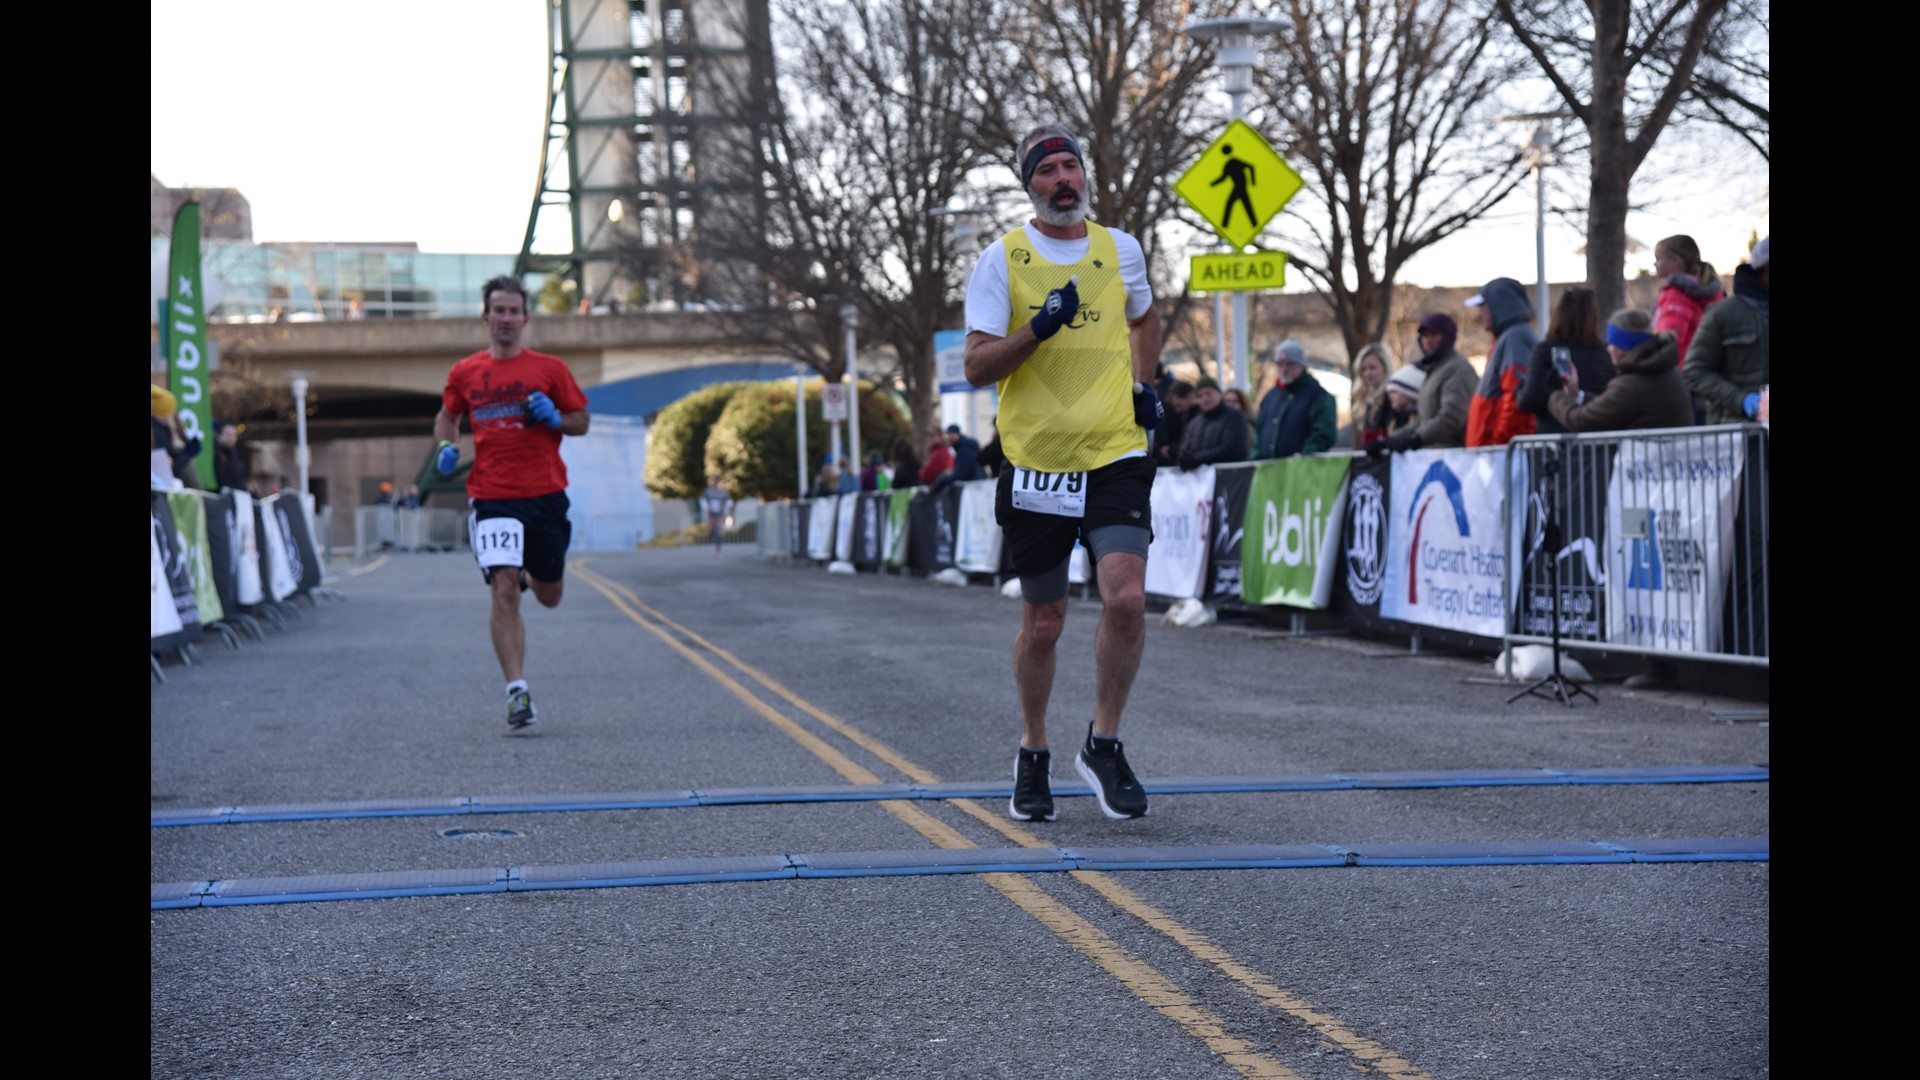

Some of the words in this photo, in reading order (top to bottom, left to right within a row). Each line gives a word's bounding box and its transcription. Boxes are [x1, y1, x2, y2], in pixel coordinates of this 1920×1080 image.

[1203, 261, 1274, 280] AHEAD
[1020, 469, 1083, 493] 1079
[480, 531, 518, 550] 1121
